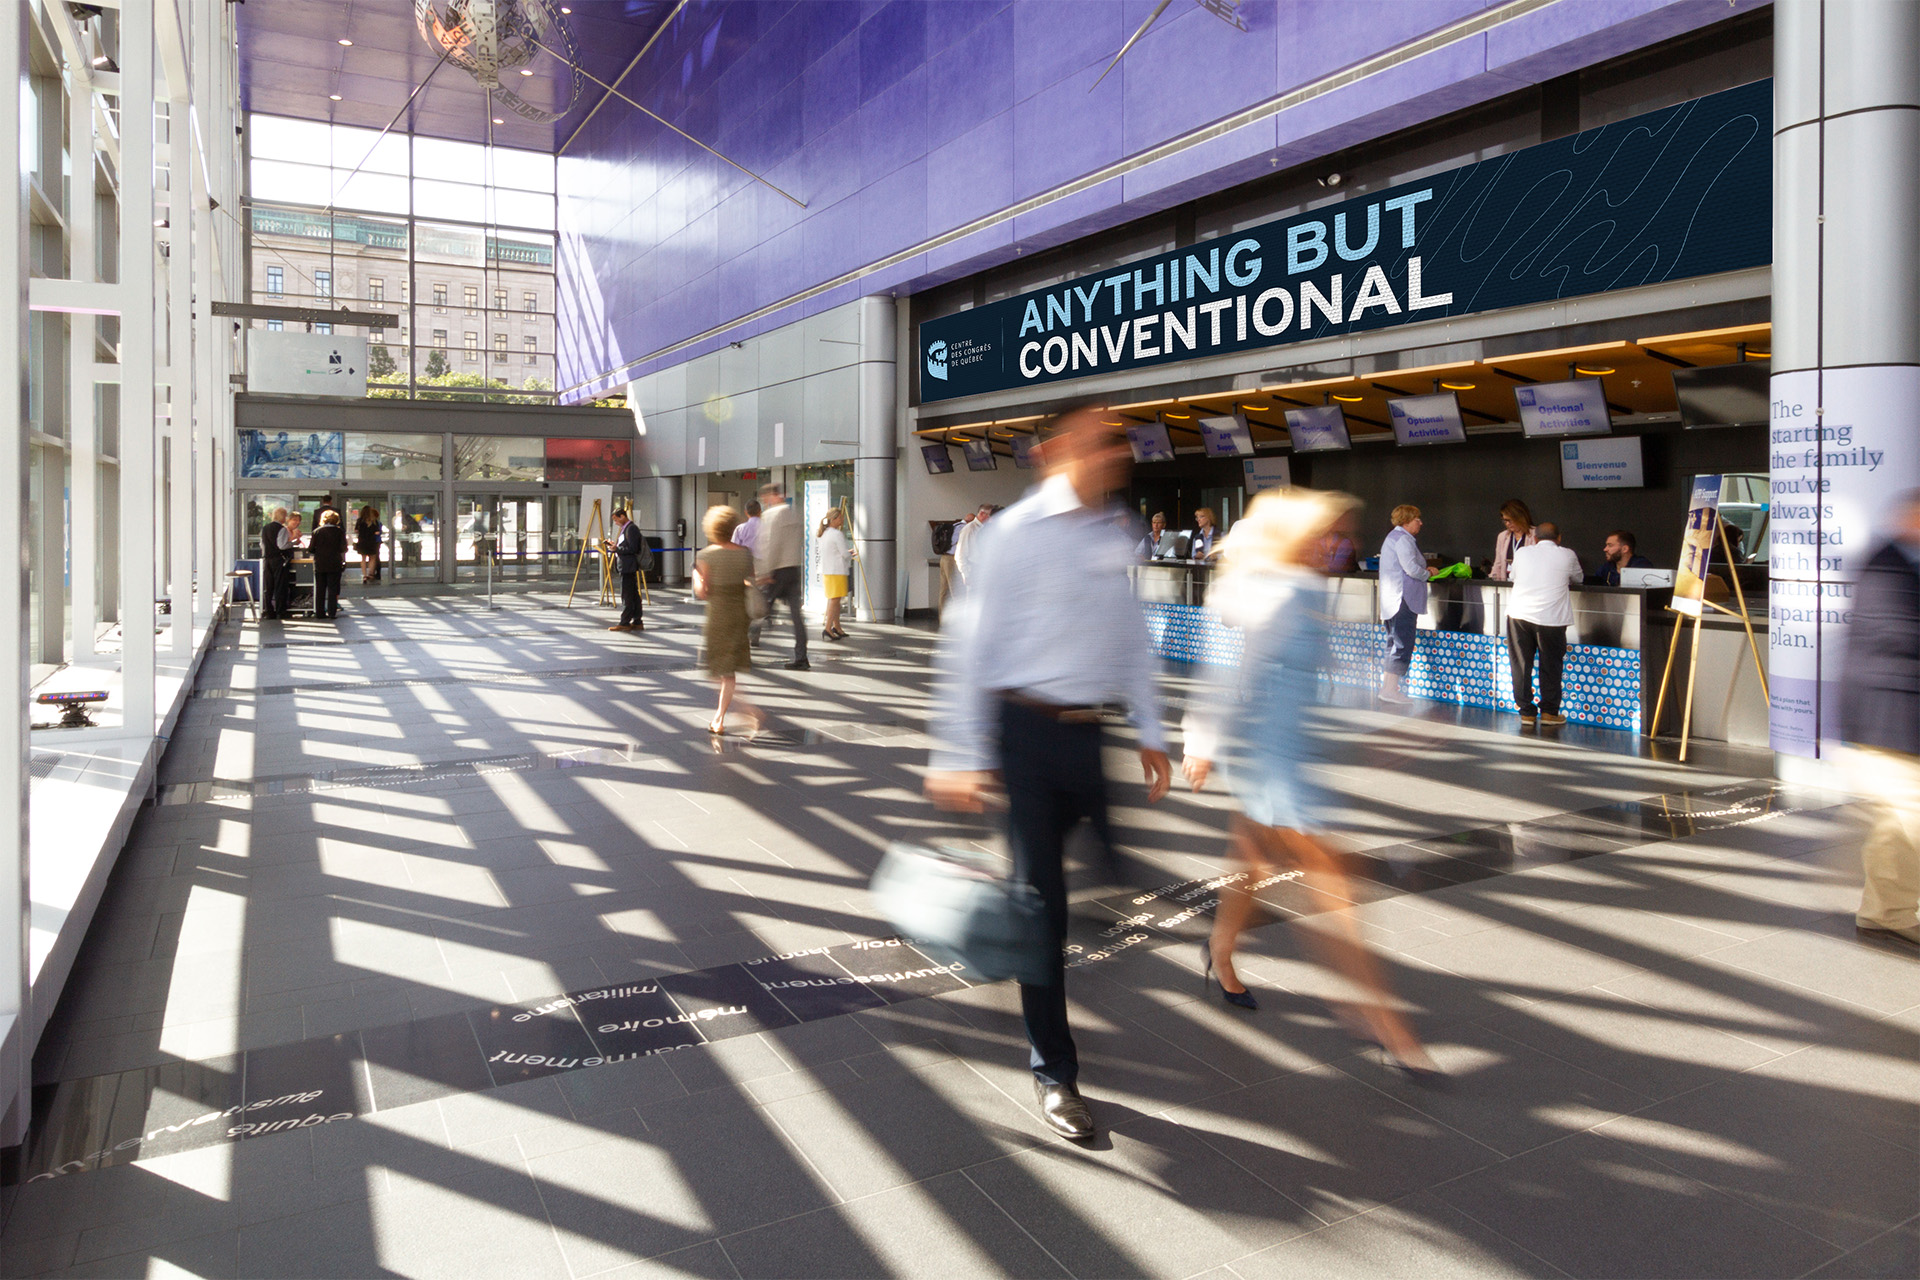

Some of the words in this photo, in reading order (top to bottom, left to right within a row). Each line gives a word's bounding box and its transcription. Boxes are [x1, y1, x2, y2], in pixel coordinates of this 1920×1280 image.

[1019, 238, 1263, 338] ANYTHING
[1287, 187, 1434, 276] BUT
[1019, 256, 1454, 379] CONVENTIONAL
[950, 339, 973, 350] CENTRE
[951, 351, 963, 359] DES
[963, 343, 992, 356] CONGRÈS
[960, 354, 984, 366] QUÉBEC
[1538, 403, 1584, 415] Optional
[1772, 399, 1803, 419] The
[1407, 414, 1444, 426] Optional
[1540, 418, 1591, 429] Activities
[1408, 428, 1450, 438] Activities
[1772, 423, 1853, 447] starting
[1576, 461, 1627, 470] Bienvenue
[1772, 450, 1796, 469] the
[1803, 446, 1883, 472] family
[1771, 501, 1834, 525] always
[1771, 526, 1843, 545] wanted
[1771, 552, 1809, 570] with
[1819, 557, 1842, 571] or
[1771, 580, 1853, 598] without
[1771, 606, 1777, 619] a
[1780, 607, 1854, 626] partne
[1771, 627, 1814, 650] plan.
[1157, 898, 1222, 929] coupures
[1098, 911, 1155, 938] religion
[512, 984, 658, 1023] militarisme
[598, 1004, 748, 1034] mémoire
